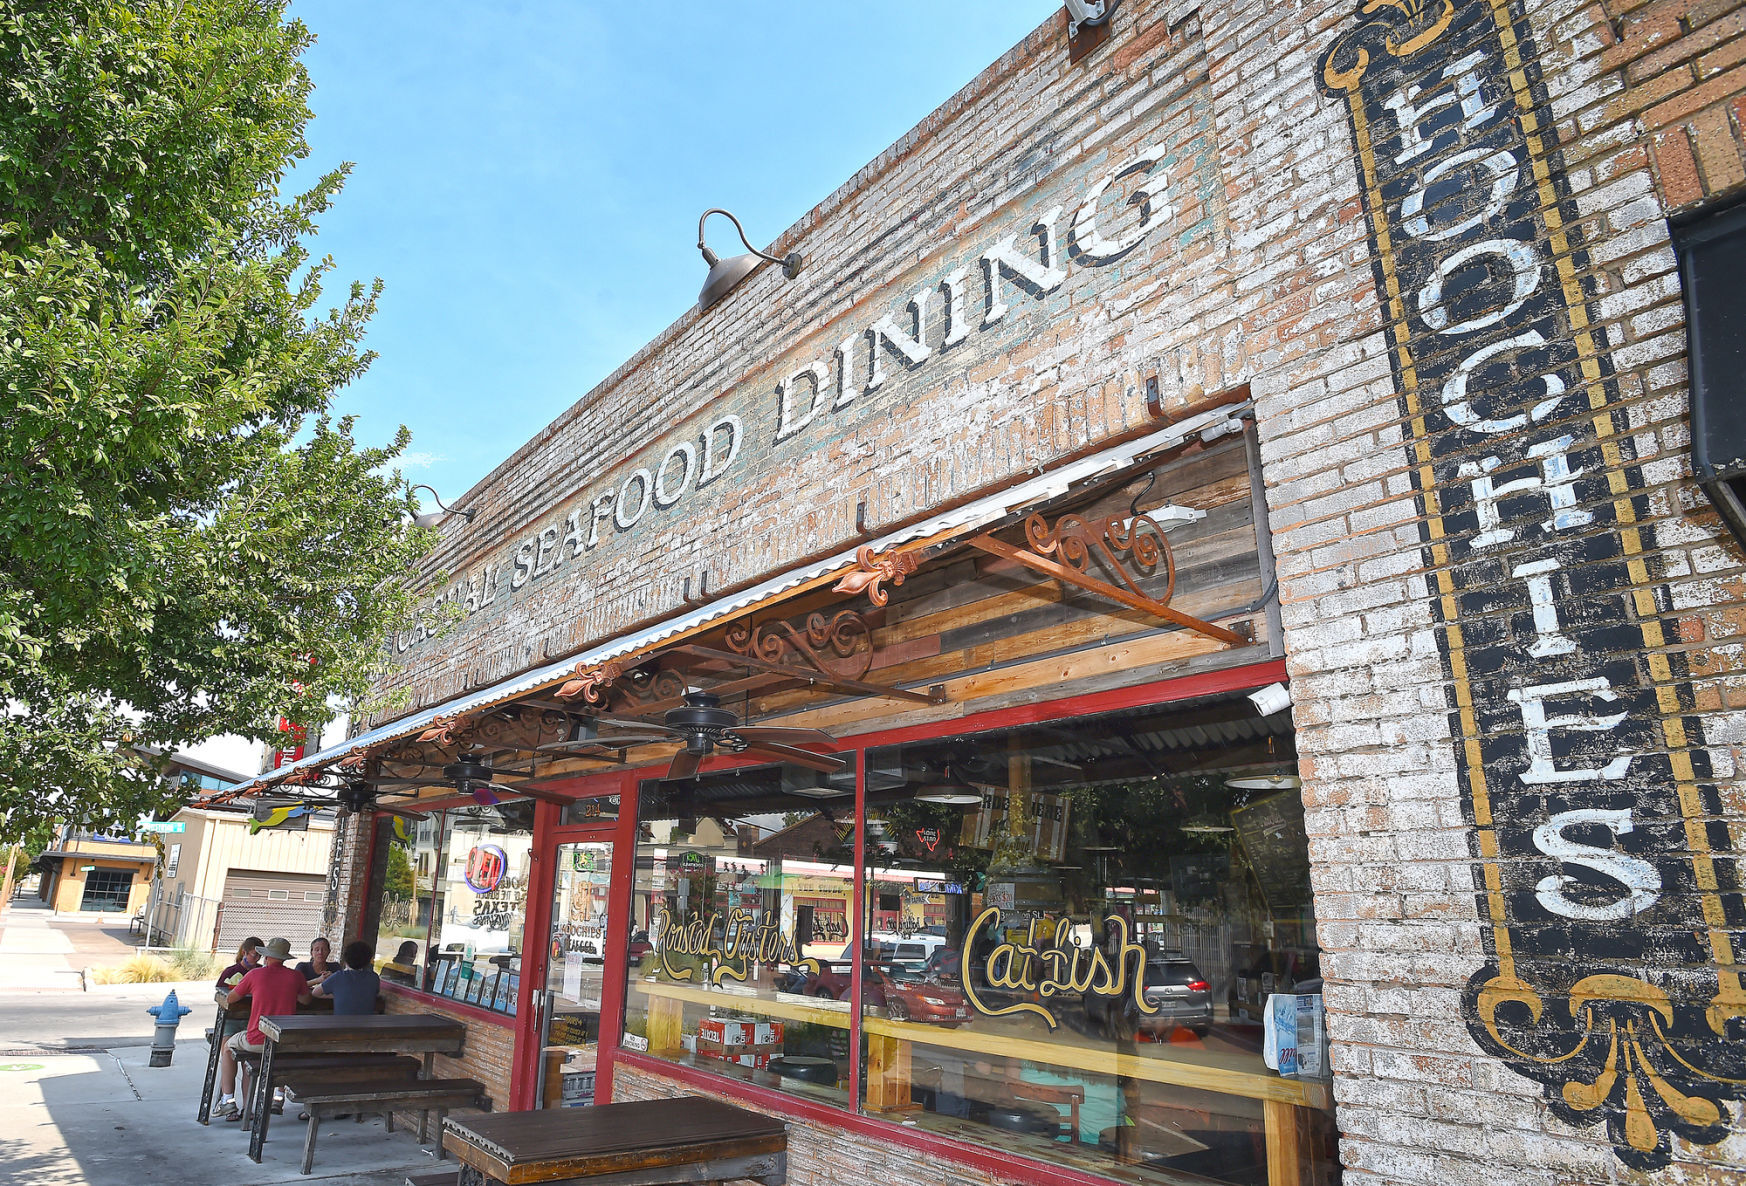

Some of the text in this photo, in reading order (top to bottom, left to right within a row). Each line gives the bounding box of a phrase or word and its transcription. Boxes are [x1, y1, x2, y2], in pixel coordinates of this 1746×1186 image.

[510, 414, 744, 592] SEAFOOD
[772, 143, 1175, 447] DINING
[1384, 50, 1662, 920] HOOCHIES
[465, 847, 502, 891] OPEN
[656, 908, 817, 987] Roasted Oysters
[962, 905, 1159, 1031] Catfish
